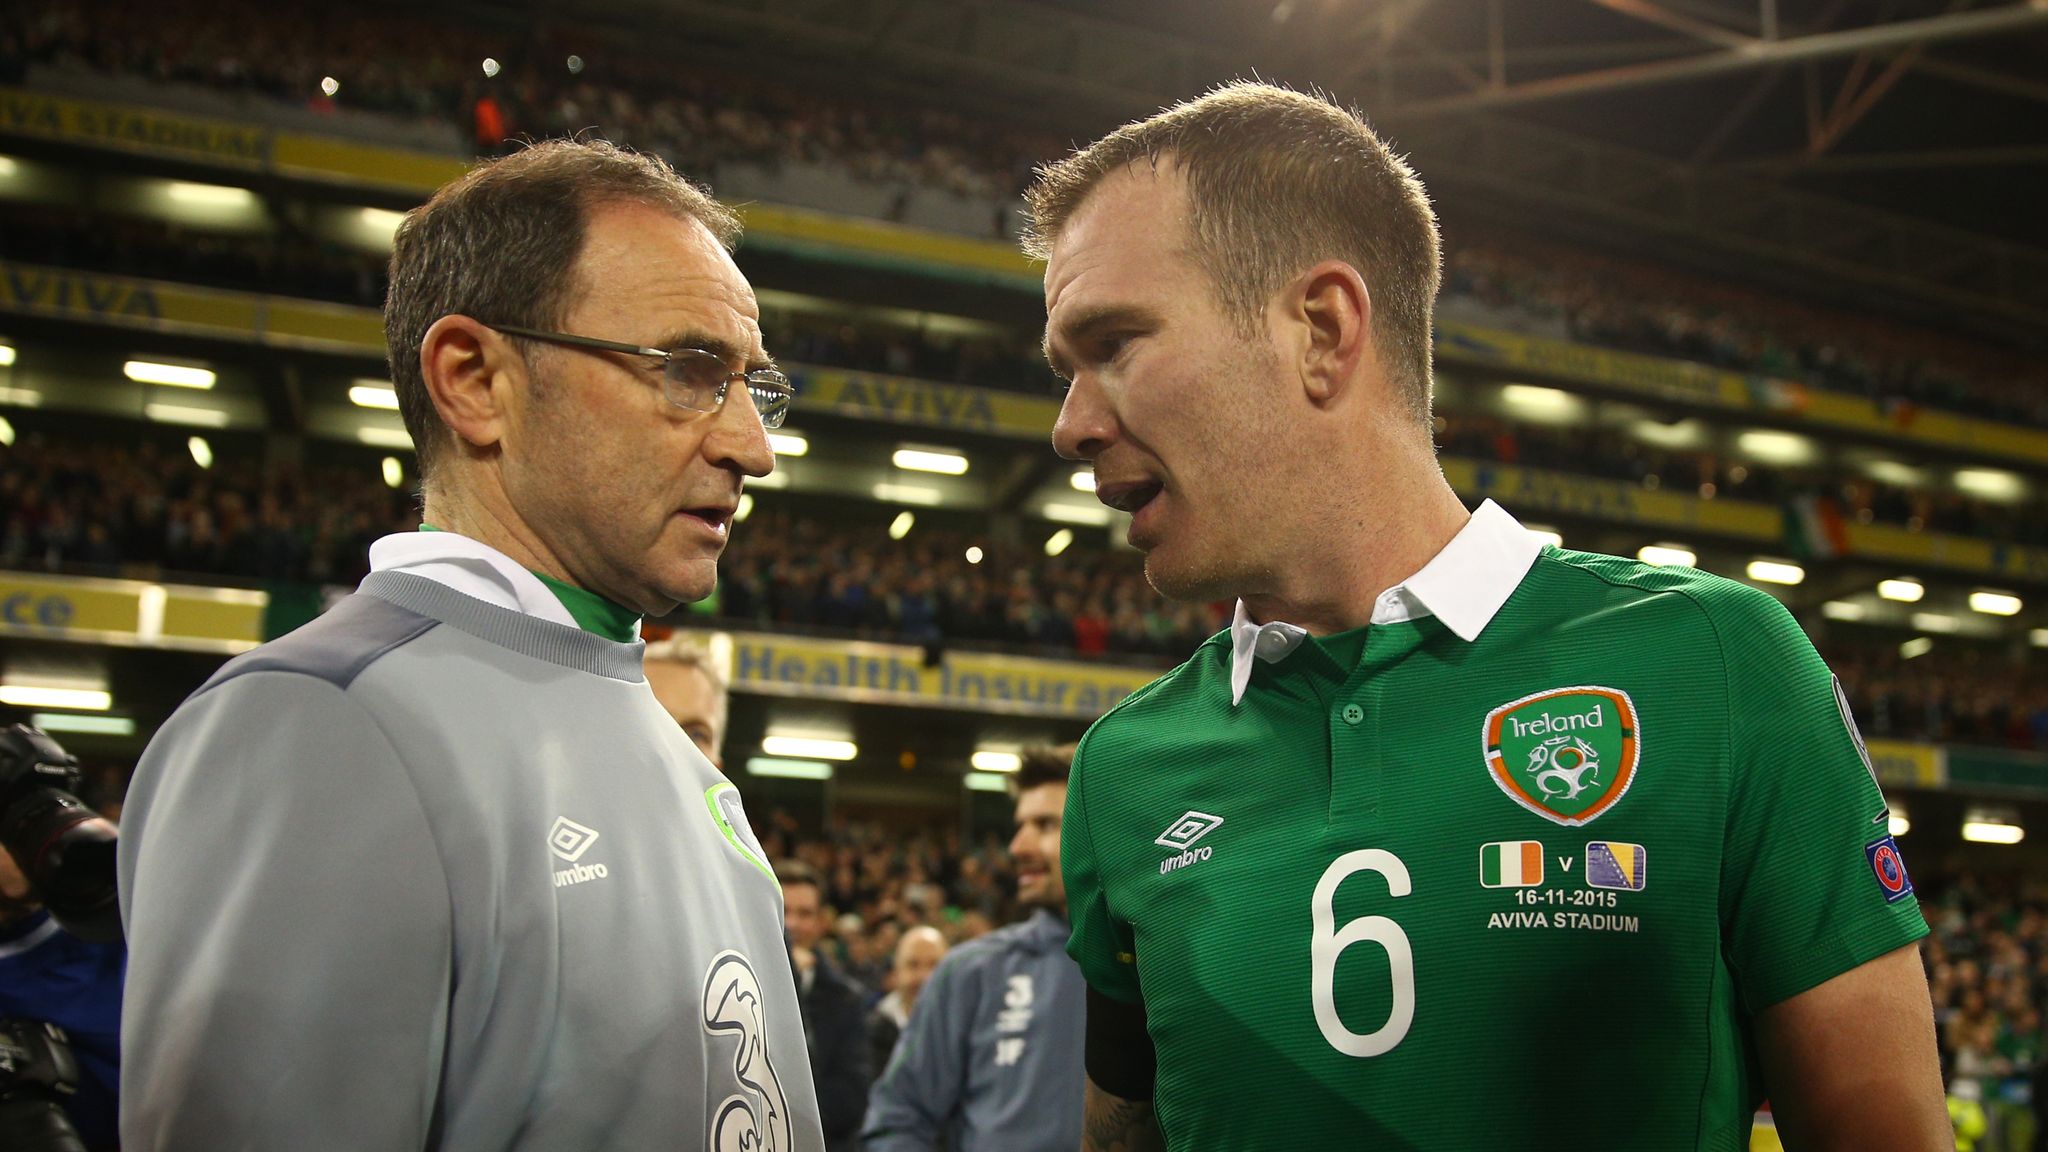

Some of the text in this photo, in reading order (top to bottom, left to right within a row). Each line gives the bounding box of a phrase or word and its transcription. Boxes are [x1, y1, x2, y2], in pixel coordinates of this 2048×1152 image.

[838, 376, 994, 430] AVIVA
[738, 646, 920, 695] Health
[1508, 704, 1603, 738] Ireland
[552, 863, 608, 888] umbro
[1160, 846, 1212, 875] umbro
[1515, 889, 1617, 908] 16-11-2015
[1487, 912, 1639, 933] AVIVA STADIUM
[1311, 849, 1415, 1058] 6
